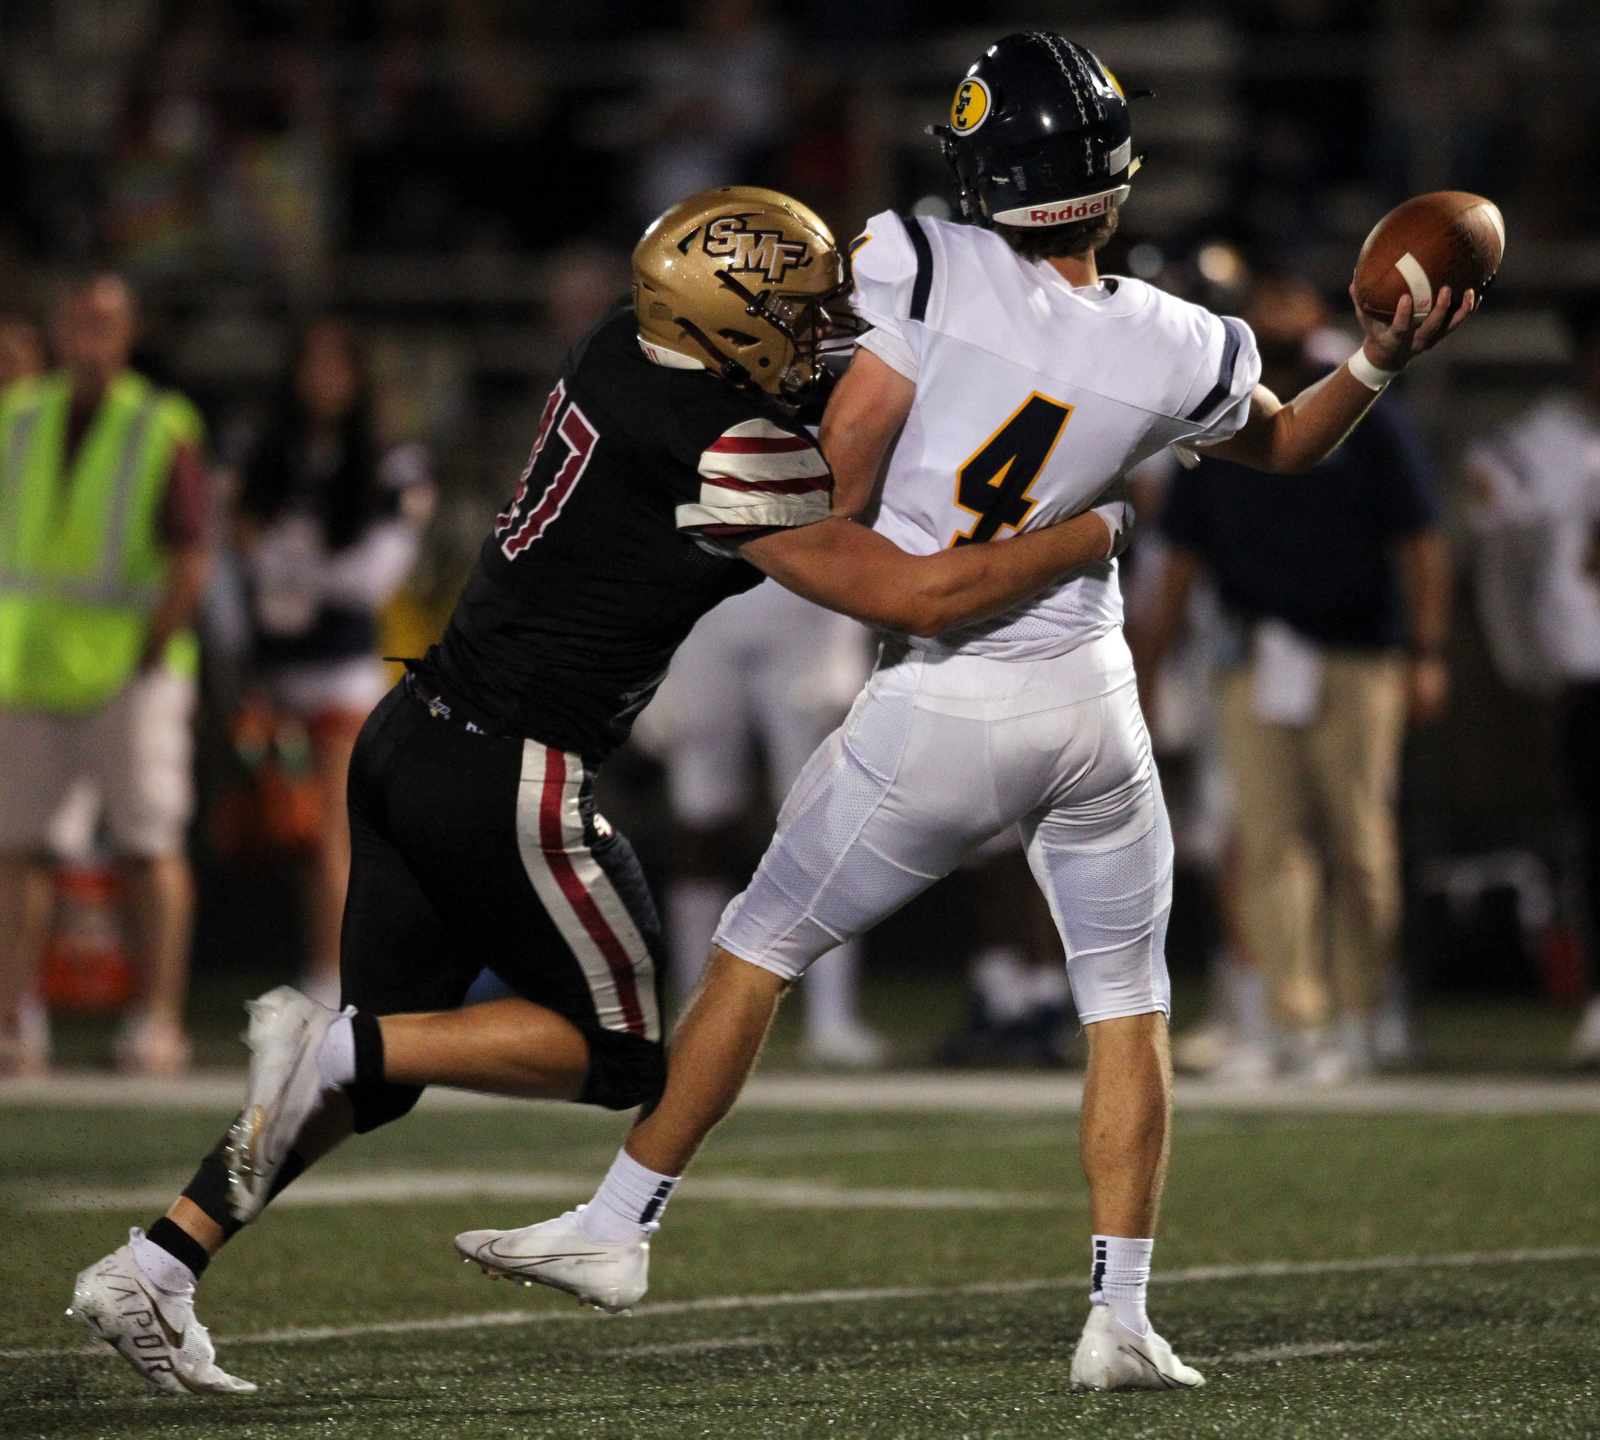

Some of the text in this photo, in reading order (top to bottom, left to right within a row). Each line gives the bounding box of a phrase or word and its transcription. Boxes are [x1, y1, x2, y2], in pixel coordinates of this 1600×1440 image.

[702, 217, 808, 284] SMF
[1030, 194, 1115, 224] Riddell
[946, 389, 1076, 550] 4
[97, 1264, 175, 1374] VAPOR
